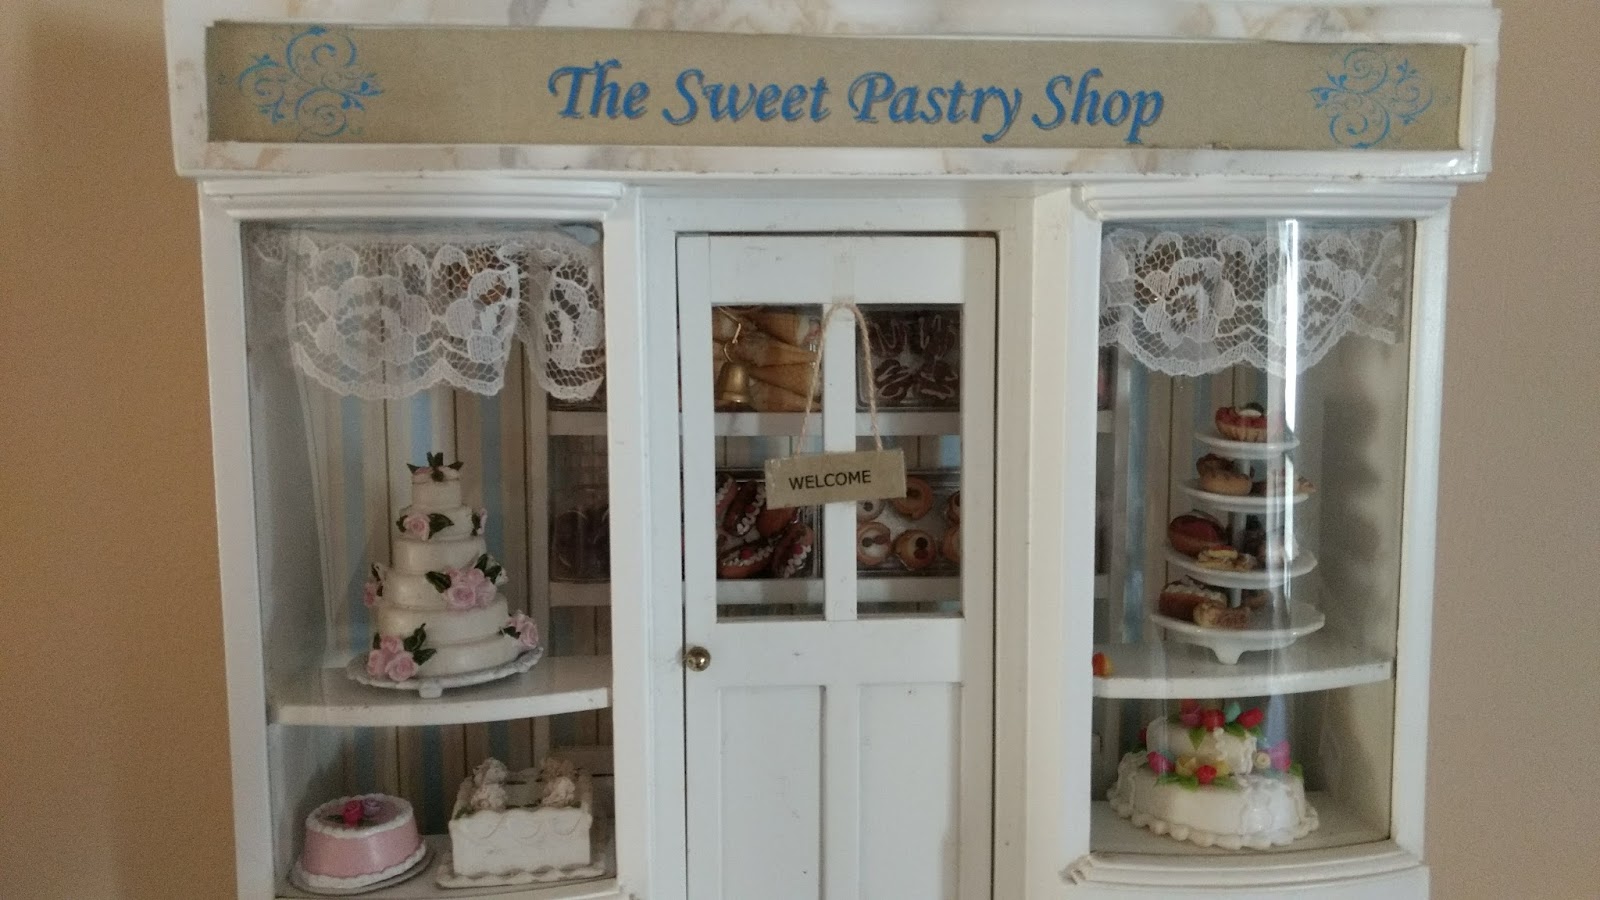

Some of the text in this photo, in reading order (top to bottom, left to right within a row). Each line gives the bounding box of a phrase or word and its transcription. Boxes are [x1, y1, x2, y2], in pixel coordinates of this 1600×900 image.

[547, 59, 1165, 145] The Sweet Pastry Shop
[788, 469, 872, 491] WELCOME
